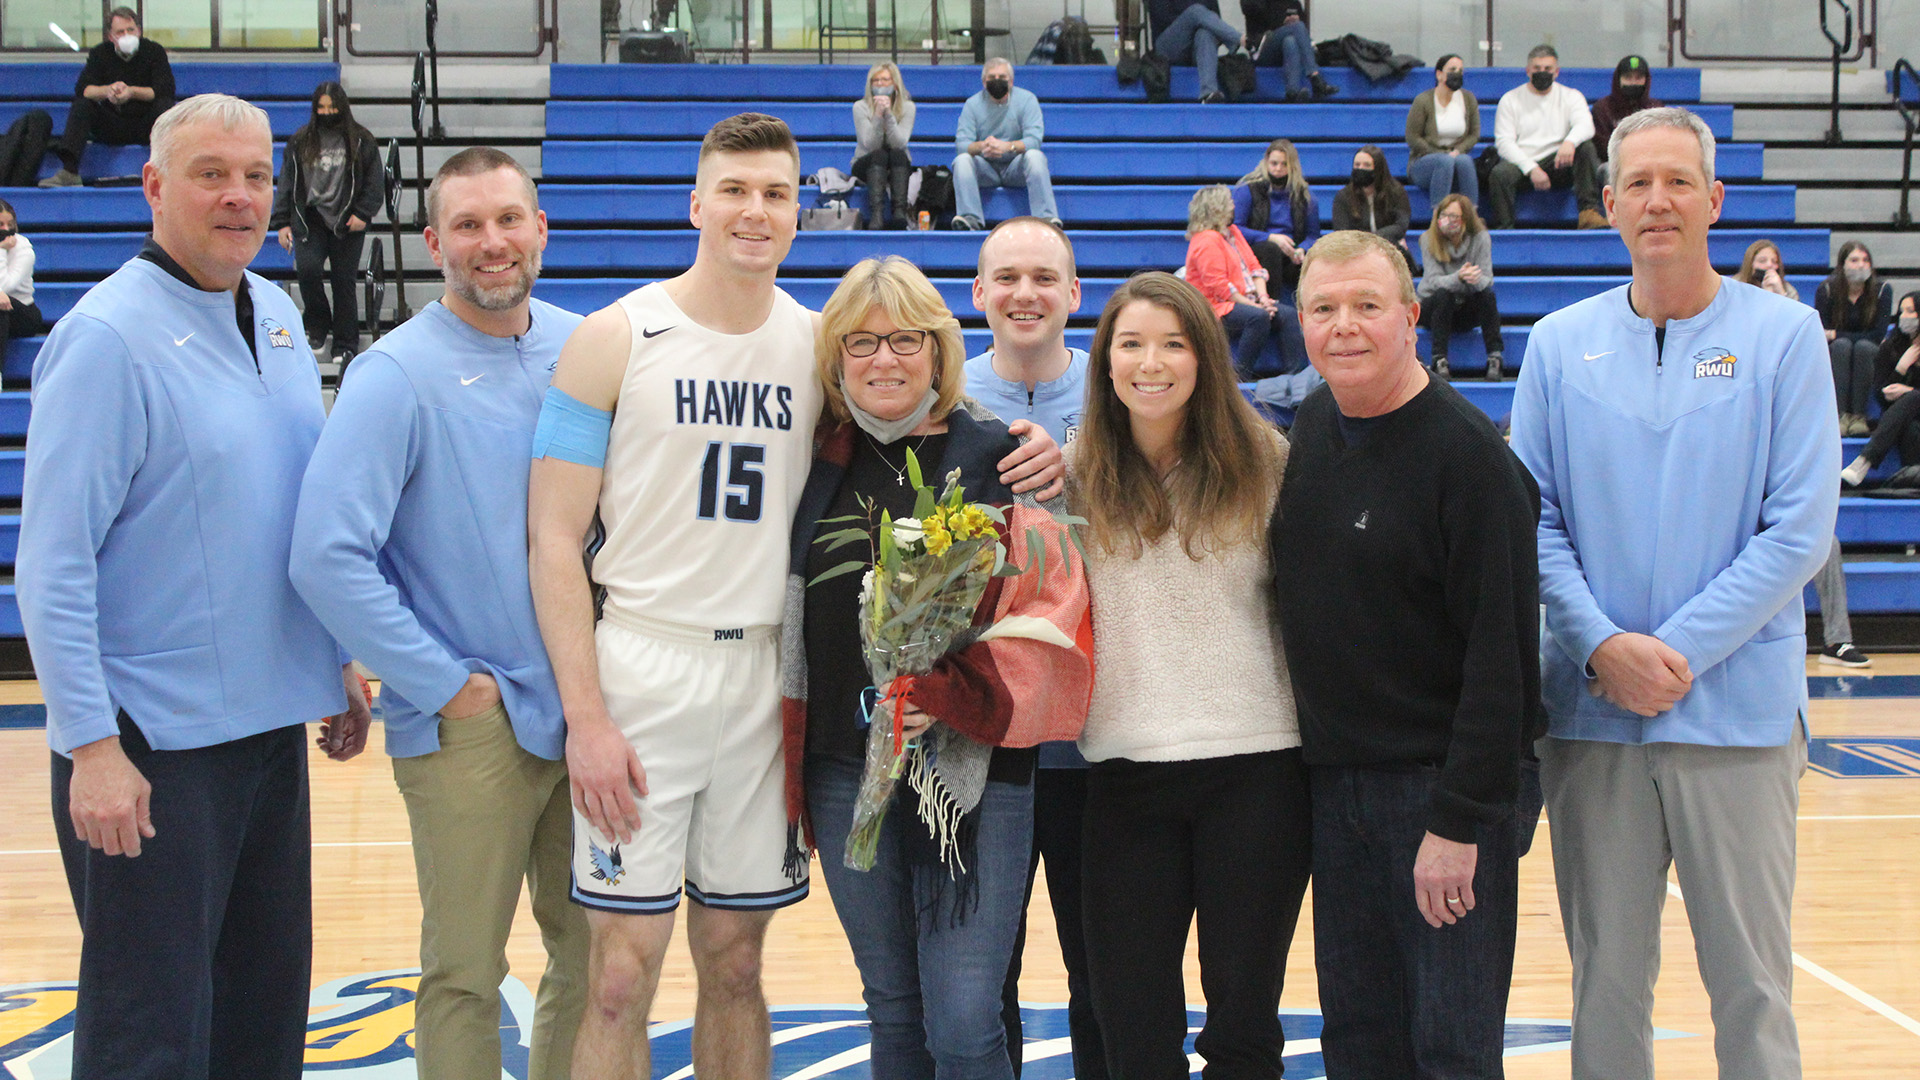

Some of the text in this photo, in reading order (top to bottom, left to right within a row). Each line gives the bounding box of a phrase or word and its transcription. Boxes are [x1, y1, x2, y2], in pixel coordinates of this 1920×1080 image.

[269, 334, 294, 349] RWU
[1695, 362, 1733, 378] RWU
[675, 379, 792, 431] HAWKS
[696, 440, 767, 524] 15
[714, 628, 743, 641] RWU
